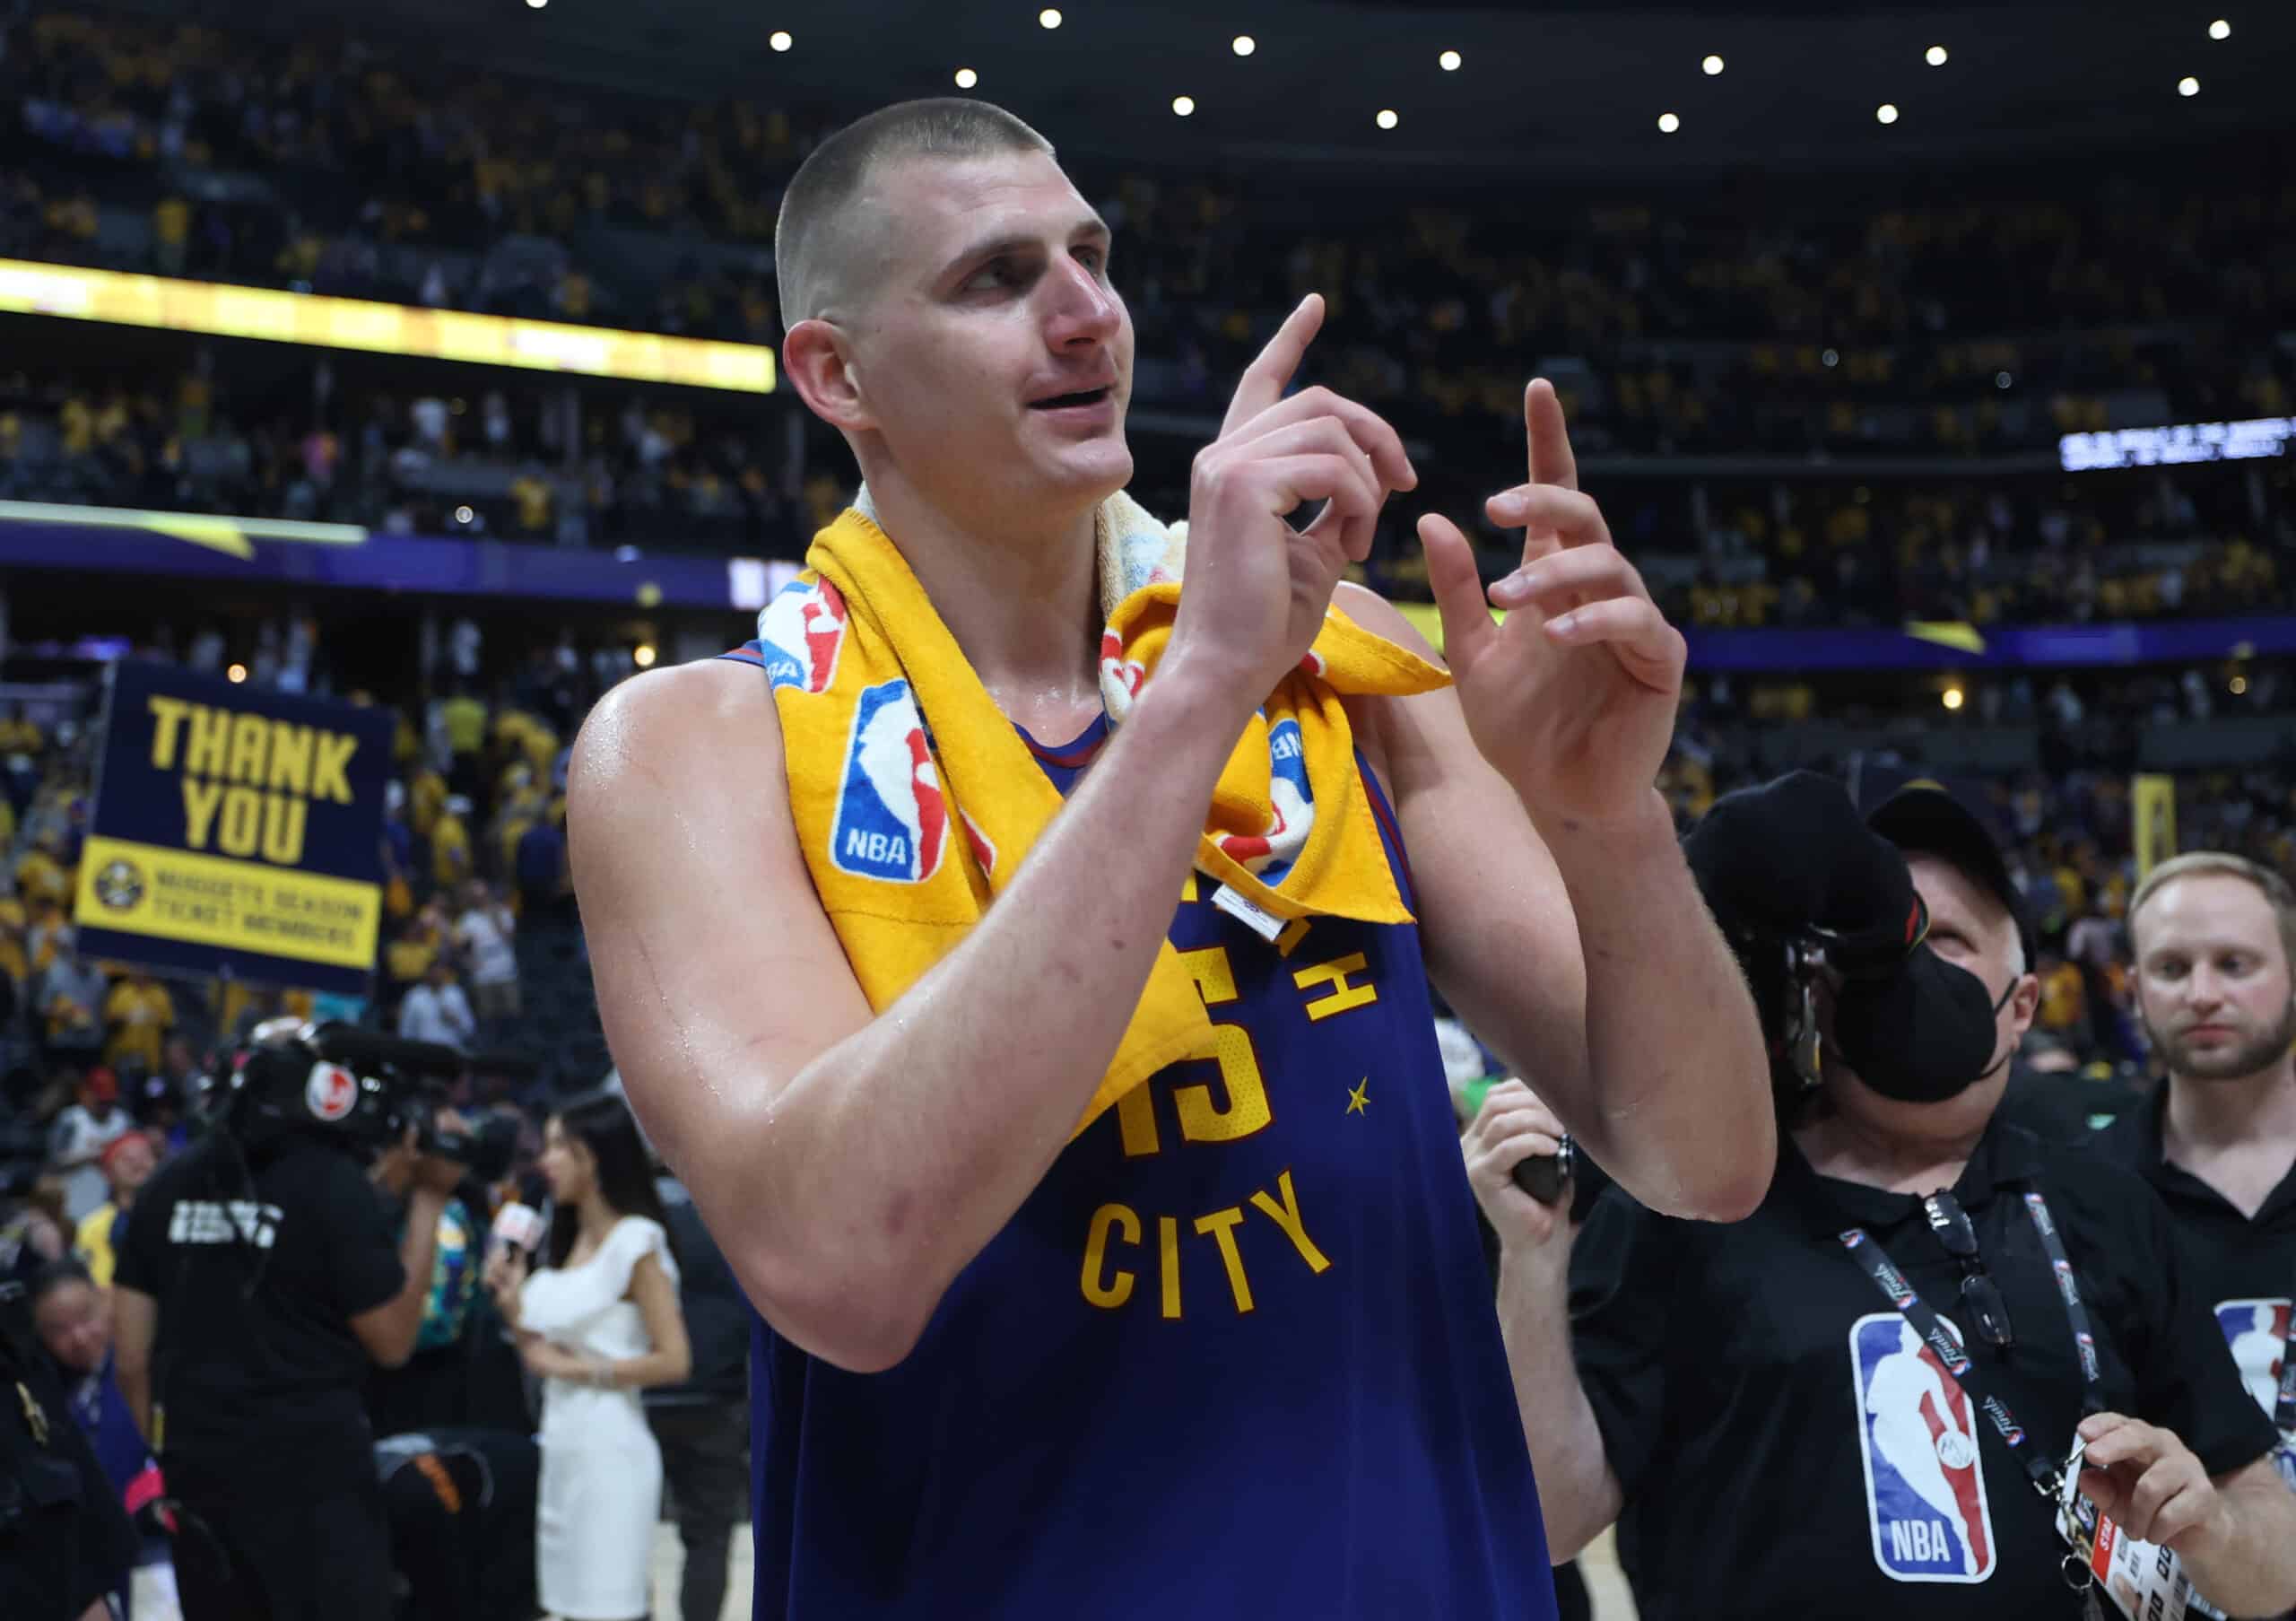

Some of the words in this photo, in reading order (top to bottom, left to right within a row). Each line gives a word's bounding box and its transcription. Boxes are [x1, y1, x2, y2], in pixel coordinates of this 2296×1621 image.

[148, 694, 357, 805] THANK
[182, 777, 308, 866] YOU
[845, 826, 907, 866] NBA
[1079, 1168, 1333, 1320] CITY
[1888, 1520, 1952, 1564] NBA
